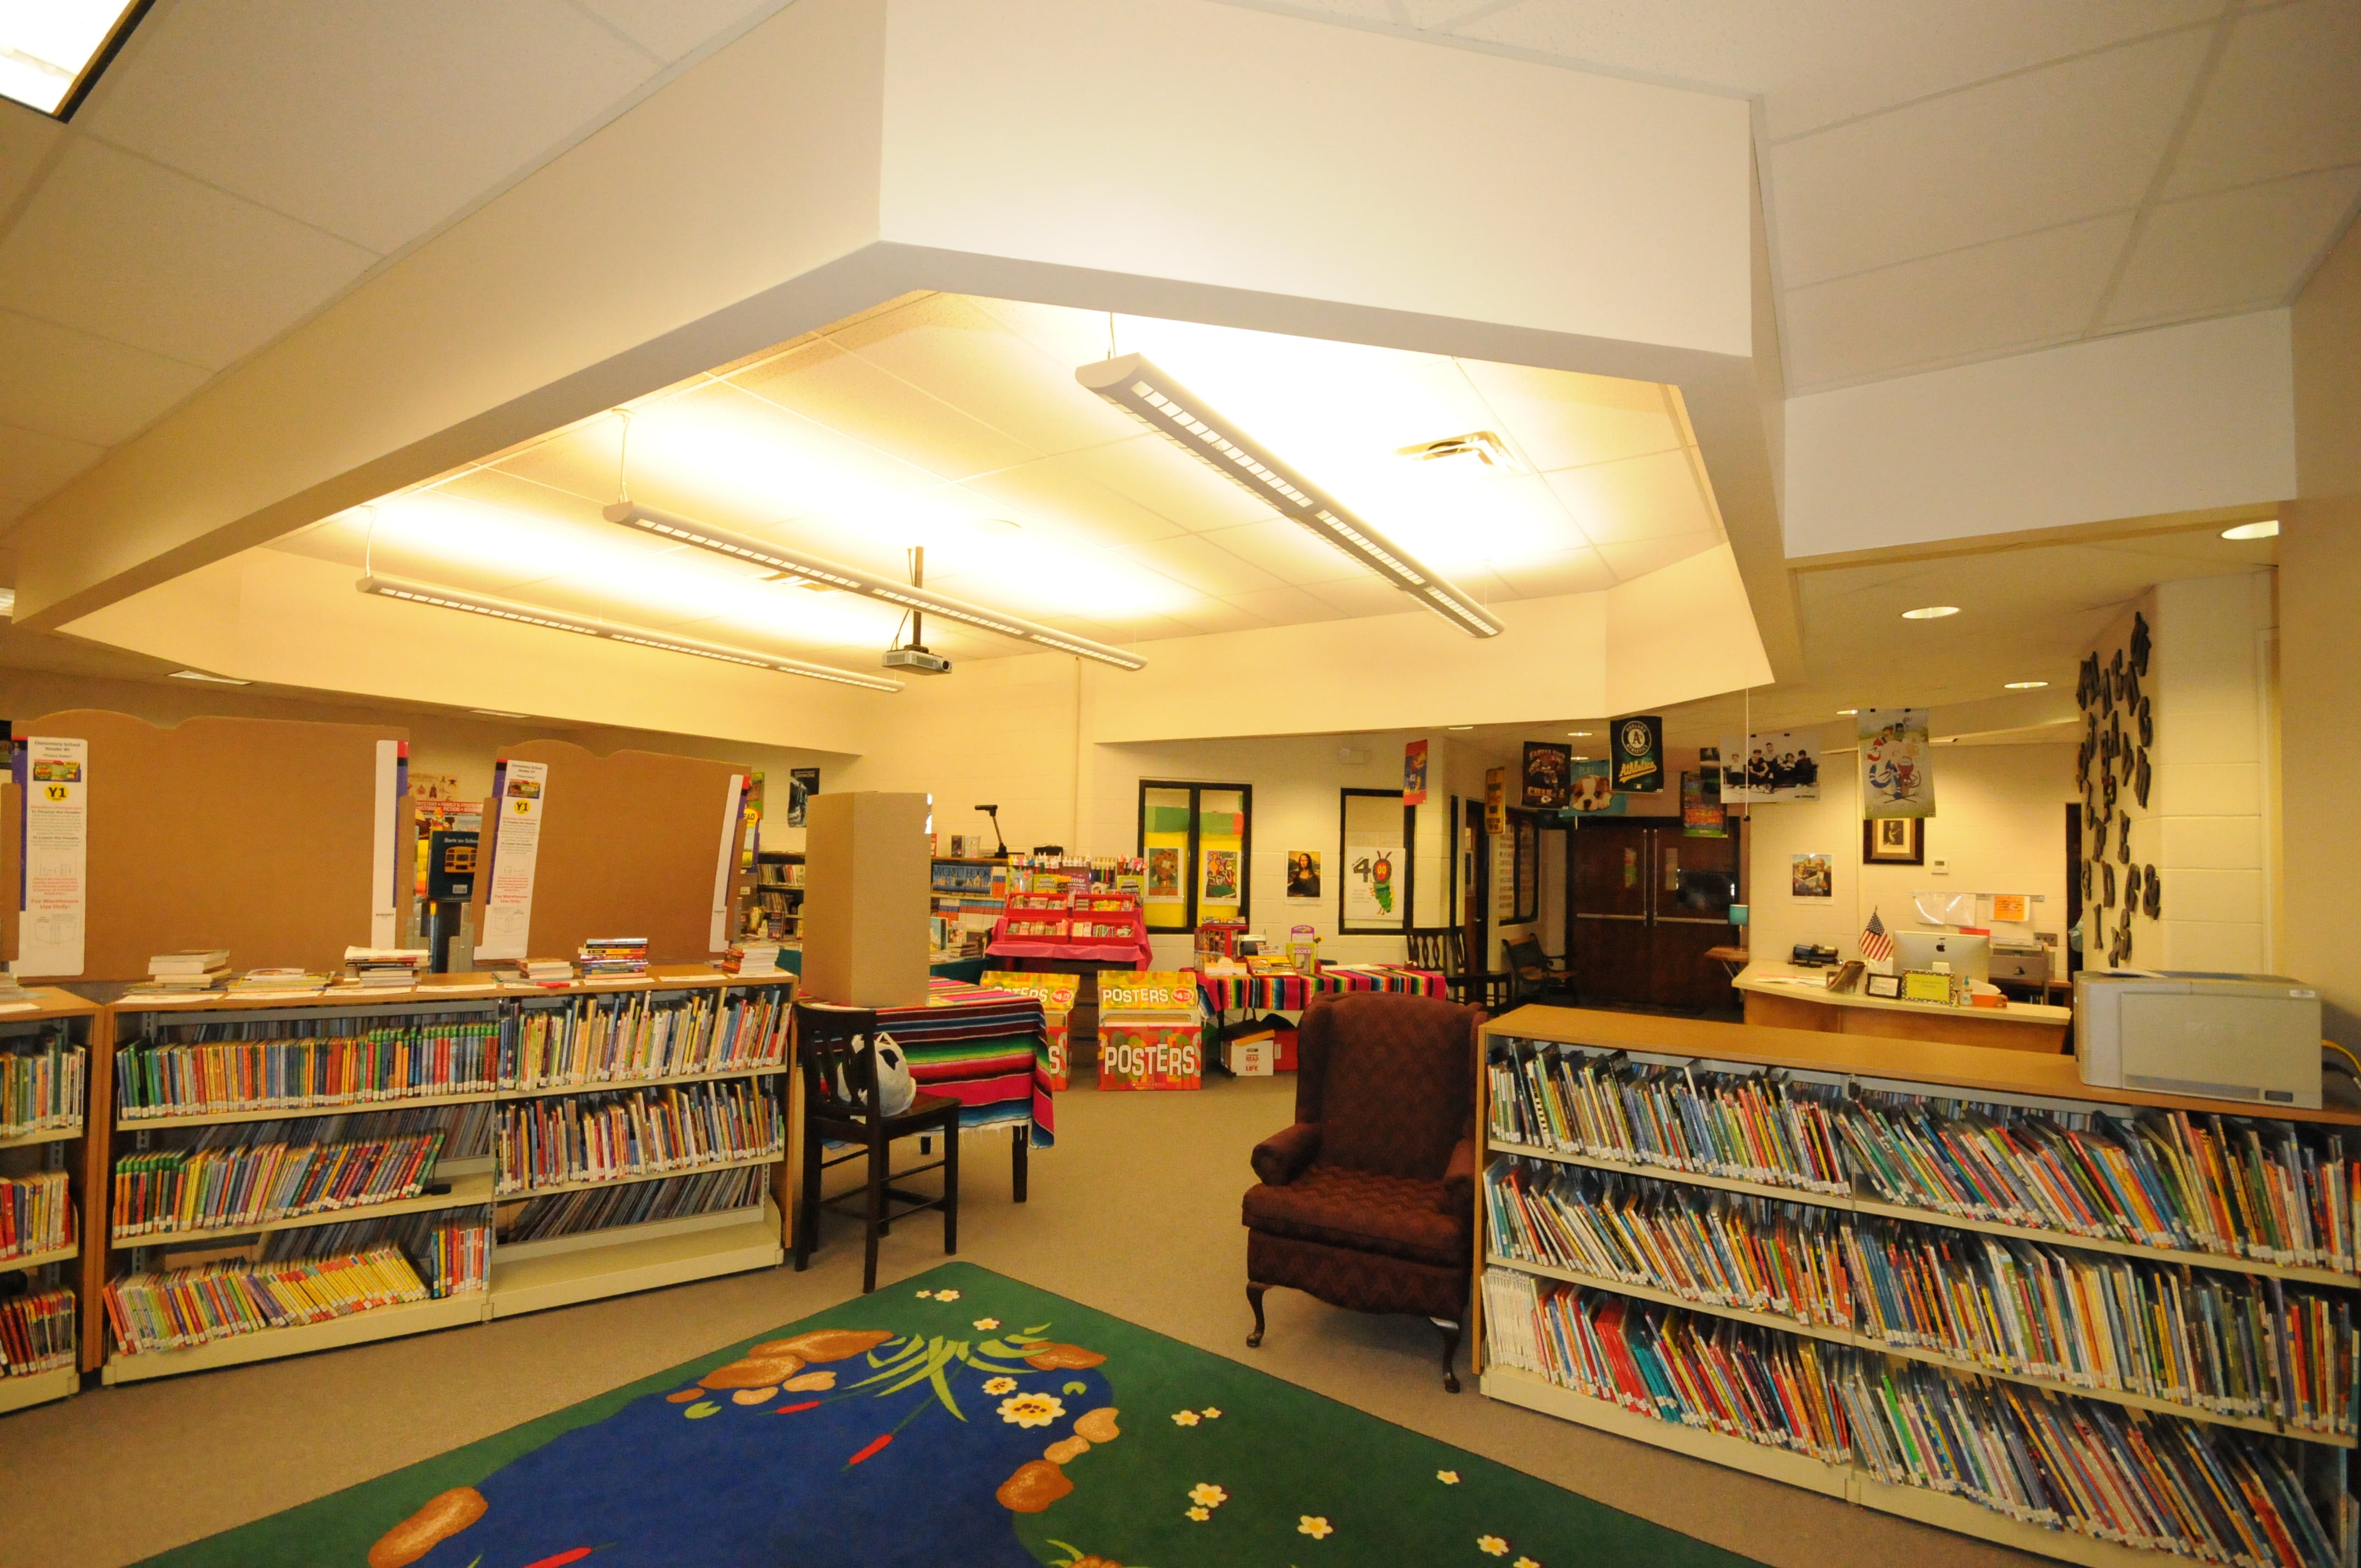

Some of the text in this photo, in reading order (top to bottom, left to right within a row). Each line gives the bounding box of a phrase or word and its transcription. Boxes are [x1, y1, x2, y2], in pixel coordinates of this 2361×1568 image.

[1618, 760, 1656, 777] Athletics
[48, 787, 66, 798] Y1
[1527, 787, 1565, 798] CHIES
[516, 802, 529, 812] Y1
[993, 986, 1049, 1003] TERS
[1102, 988, 1169, 1003] POSTERS
[1104, 1043, 1195, 1077] POSTERS
